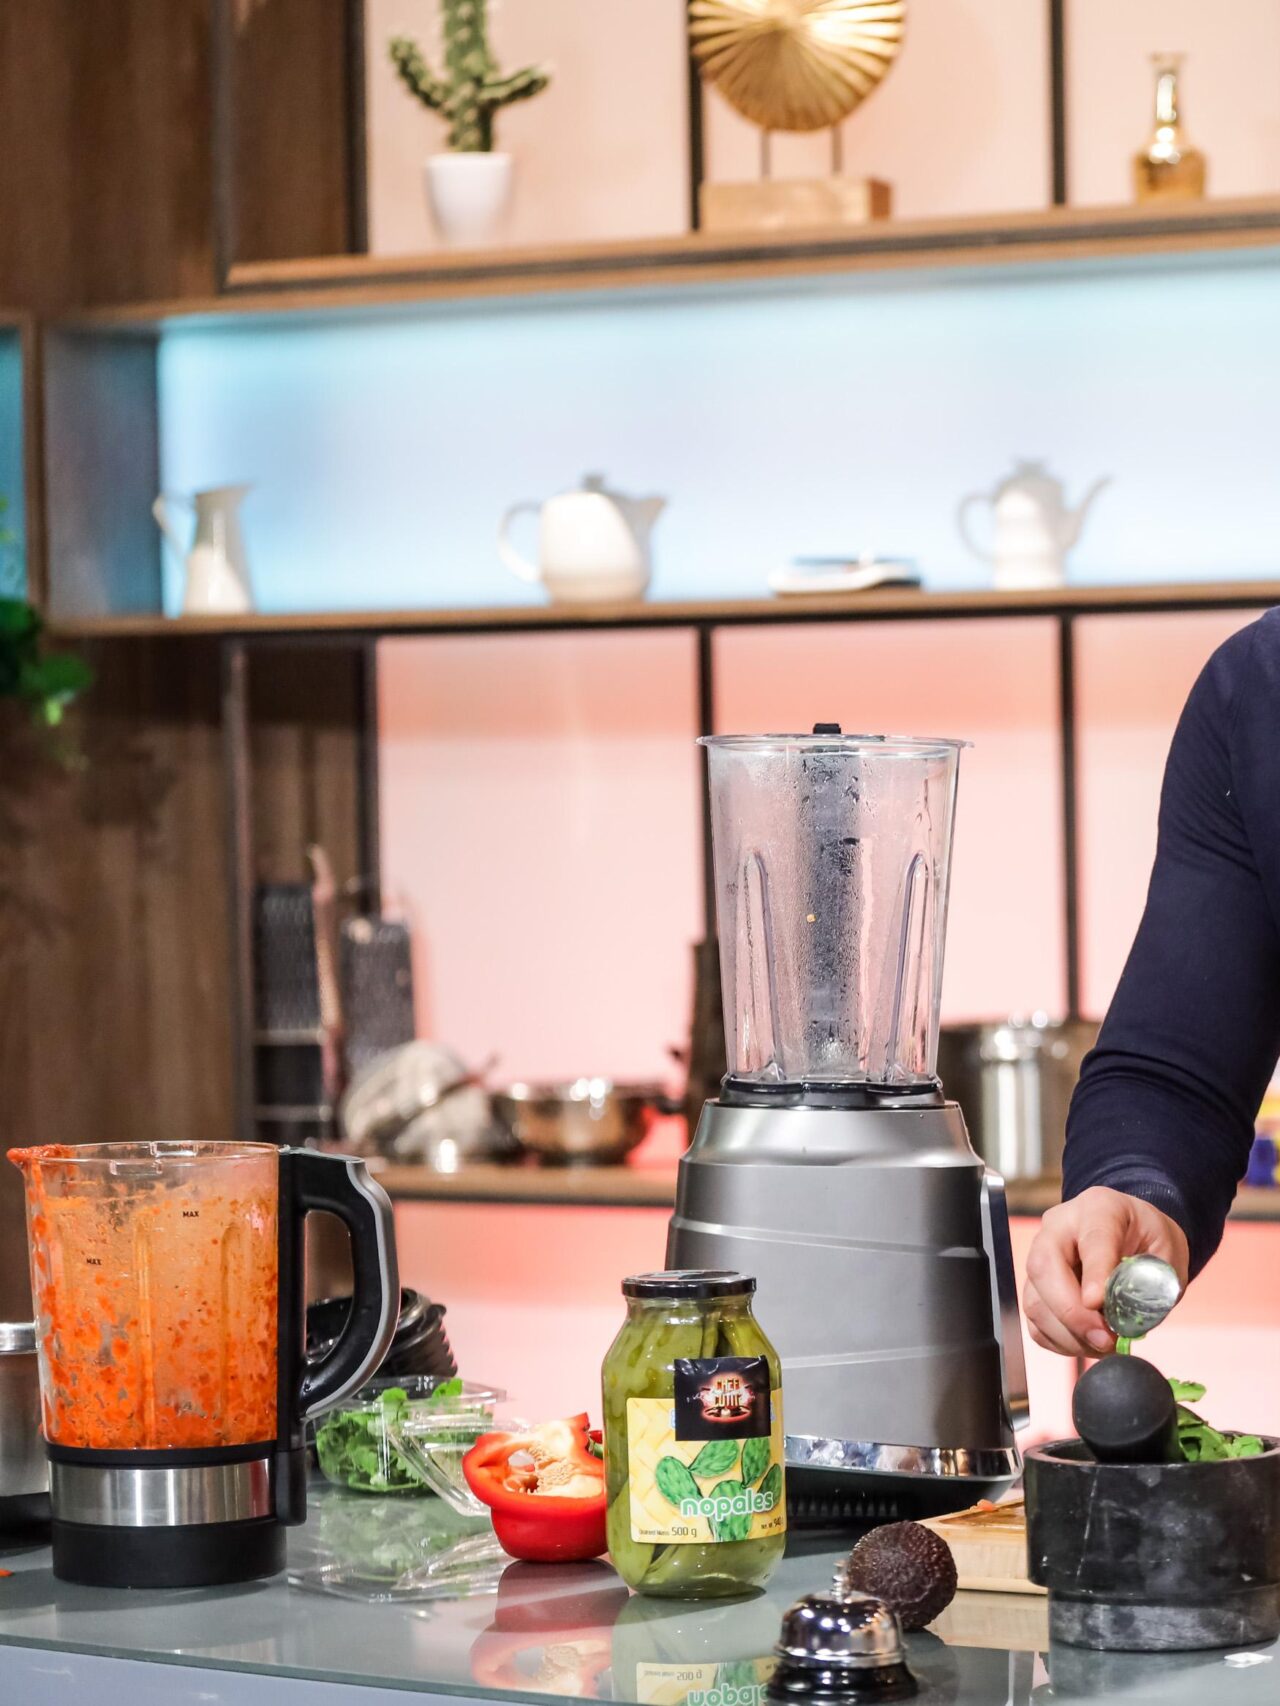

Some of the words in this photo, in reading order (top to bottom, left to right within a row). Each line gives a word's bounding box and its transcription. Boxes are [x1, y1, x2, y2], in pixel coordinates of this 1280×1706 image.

[183, 1210, 199, 1218] MAX
[86, 1258, 101, 1266] MAX
[680, 1489, 773, 1521] nopales
[671, 1526, 689, 1536] 500
[690, 1528, 697, 1538] g
